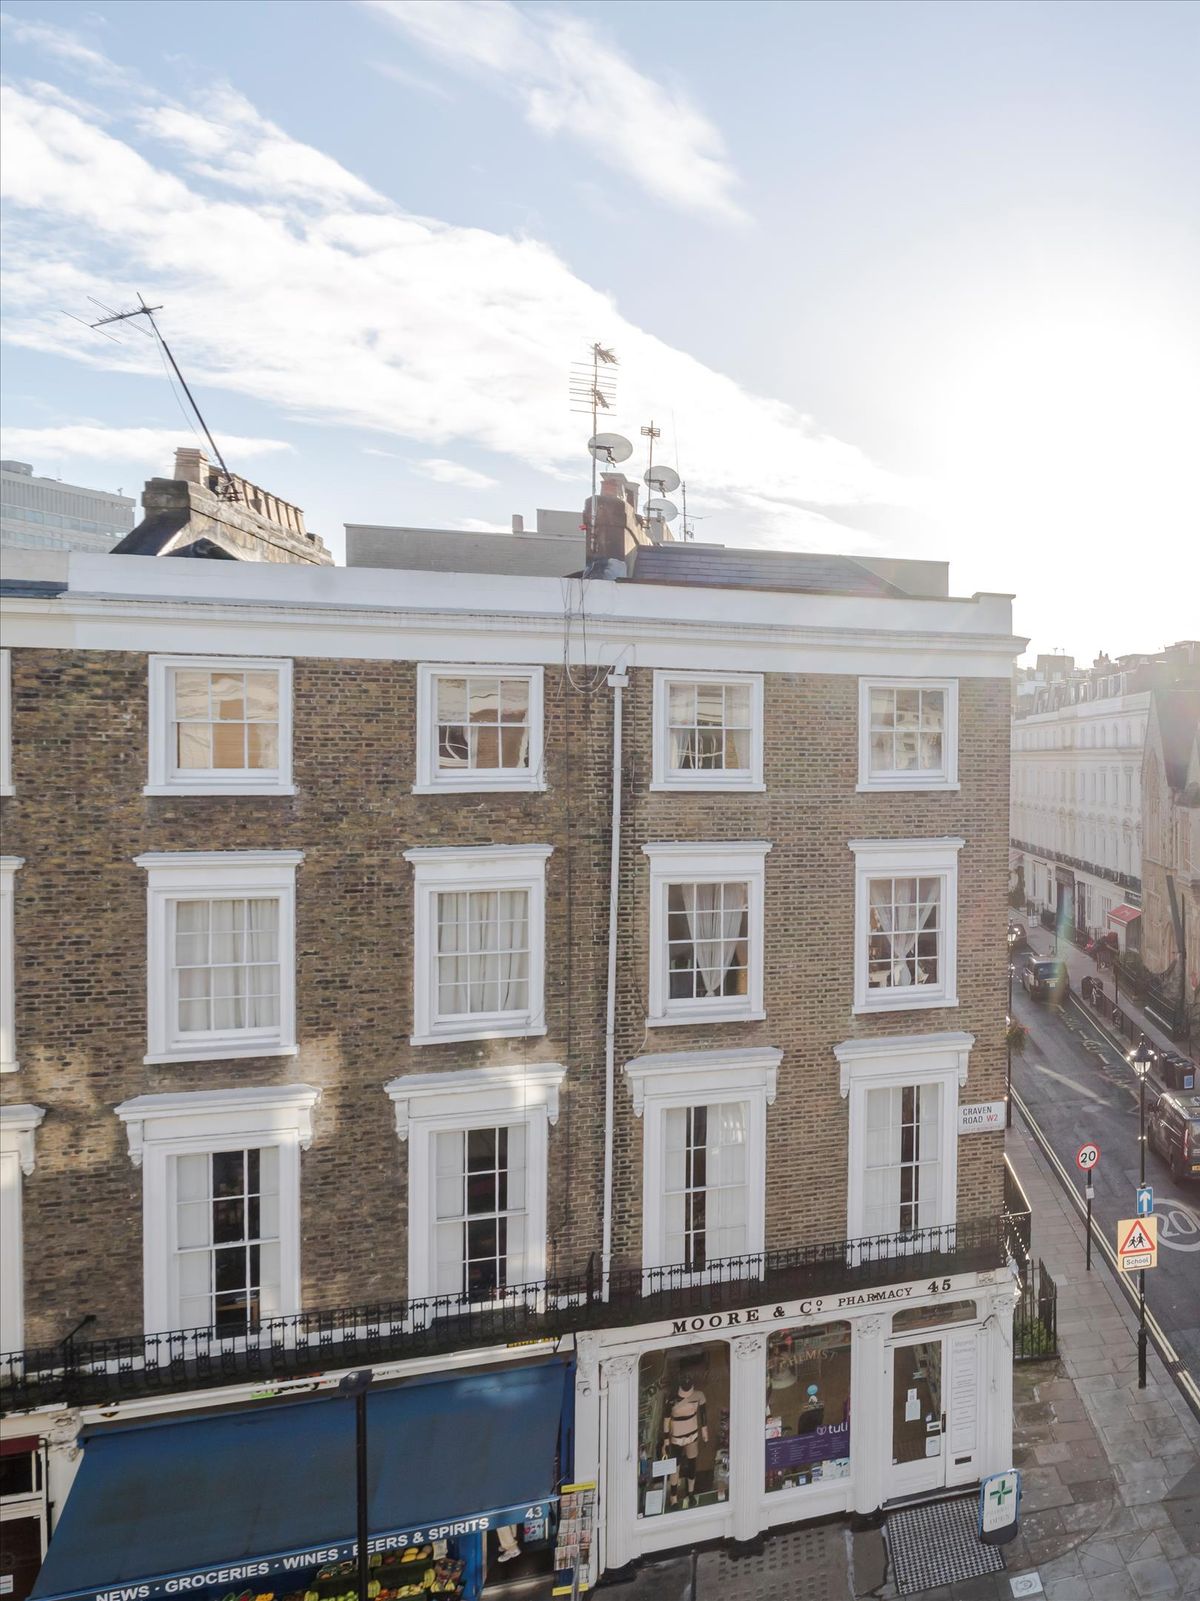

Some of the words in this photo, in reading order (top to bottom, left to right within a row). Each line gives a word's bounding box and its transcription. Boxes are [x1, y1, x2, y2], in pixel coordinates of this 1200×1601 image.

[962, 1106, 992, 1116] CRAVEN
[963, 1115, 983, 1124] ROAD
[986, 1114, 998, 1122] W2
[1080, 1151, 1096, 1163] 20
[1149, 1210, 1198, 1238] 20
[1126, 1257, 1149, 1266] School
[672, 1309, 759, 1334] MOORE
[773, 1305, 785, 1318] &
[838, 1286, 913, 1307] PHARMACY
[927, 1279, 951, 1294] 45
[525, 1506, 543, 1520] 43
[95, 1585, 150, 1601] NEWS
[165, 1562, 270, 1593] GROCERIES
[283, 1548, 340, 1569] WINES
[412, 1529, 425, 1543] &
[428, 1517, 490, 1541] SPIRITS
